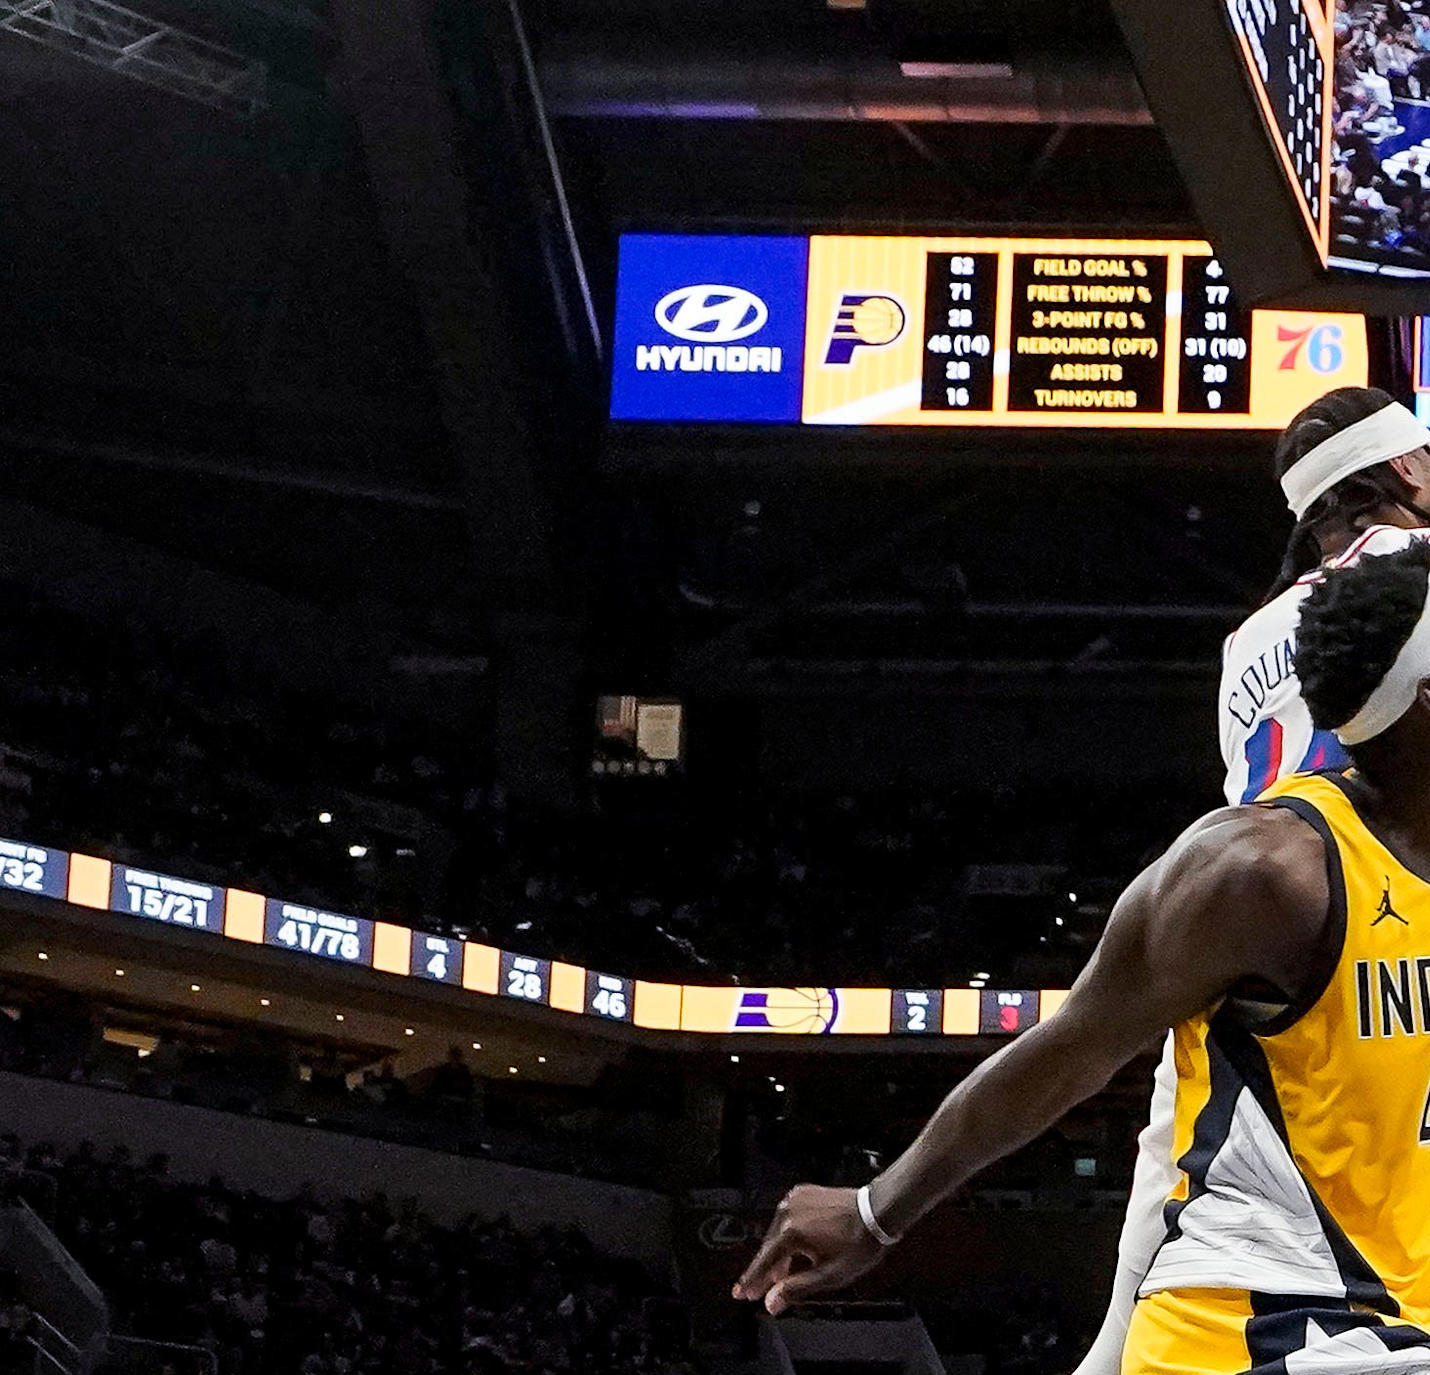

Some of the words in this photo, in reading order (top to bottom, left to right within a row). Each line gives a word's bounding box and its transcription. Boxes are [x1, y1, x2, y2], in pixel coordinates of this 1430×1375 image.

[1034, 259, 1081, 276] FIELD
[1084, 260, 1130, 277] GOAL
[1027, 285, 1070, 302] FREE
[1072, 285, 1135, 303] THROW
[1206, 286, 1229, 304] 77
[1032, 311, 1102, 329] 3-POINT
[636, 345, 781, 373] HYUNDAI
[1017, 337, 1110, 355] REBOUNDS
[1112, 337, 1158, 359] (OFF)
[1276, 325, 1343, 372] 76
[1050, 364, 1123, 381] ASSISTS
[1034, 390, 1137, 408] TURNOVERS
[1229, 627, 1300, 729] COUN
[127, 884, 209, 927] 15/21
[277, 919, 360, 960] 41/78
[426, 953, 448, 979] 4
[507, 970, 542, 1000] 28
[592, 989, 627, 1018] 46
[907, 1005, 927, 1031] 2
[1000, 1006, 1019, 1032] 3
